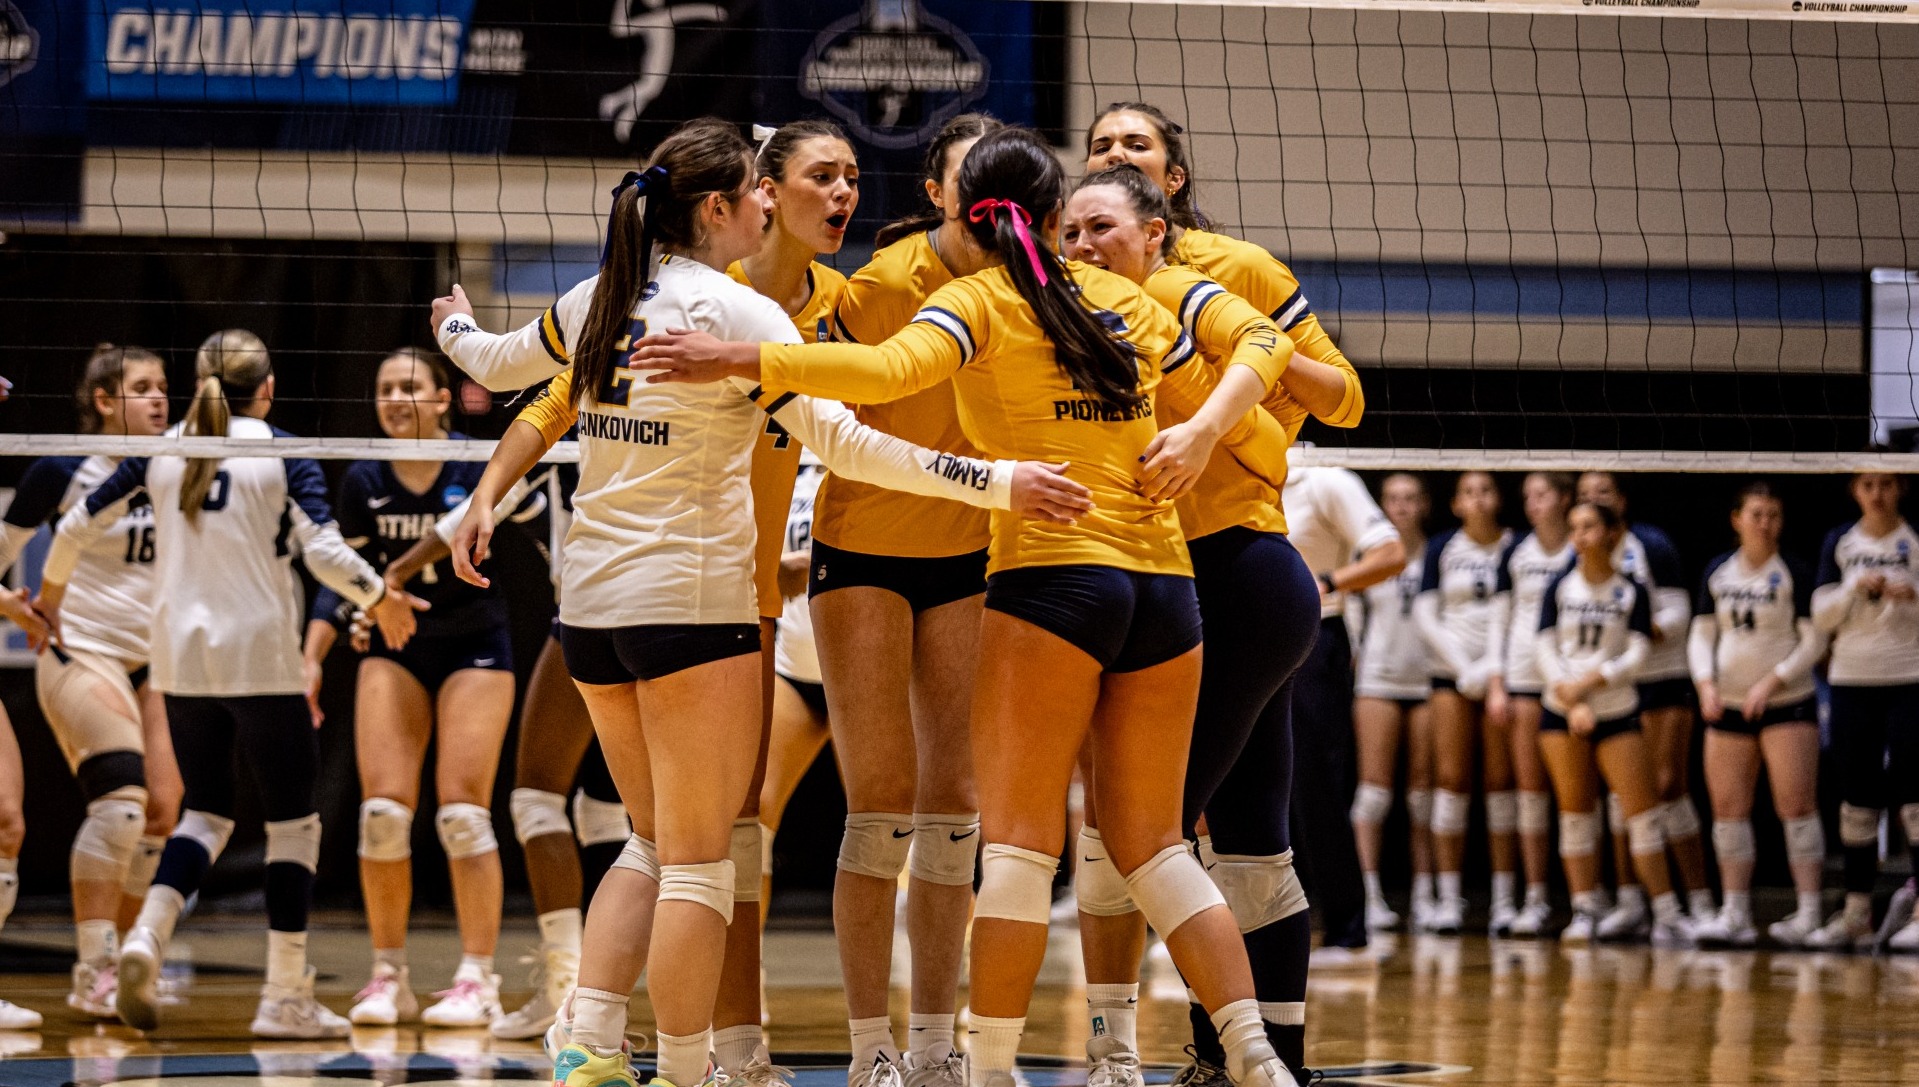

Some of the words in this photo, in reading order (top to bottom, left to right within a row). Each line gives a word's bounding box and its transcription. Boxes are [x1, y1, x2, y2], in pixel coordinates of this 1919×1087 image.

[1804, 2, 1847, 12] VOLLEYBALL
[1849, 3, 1908, 13] CHAMPIONSHIP
[107, 8, 463, 80] CHAMPIONS
[577, 410, 670, 446] ANKOVICH
[925, 453, 991, 491] FAMILY
